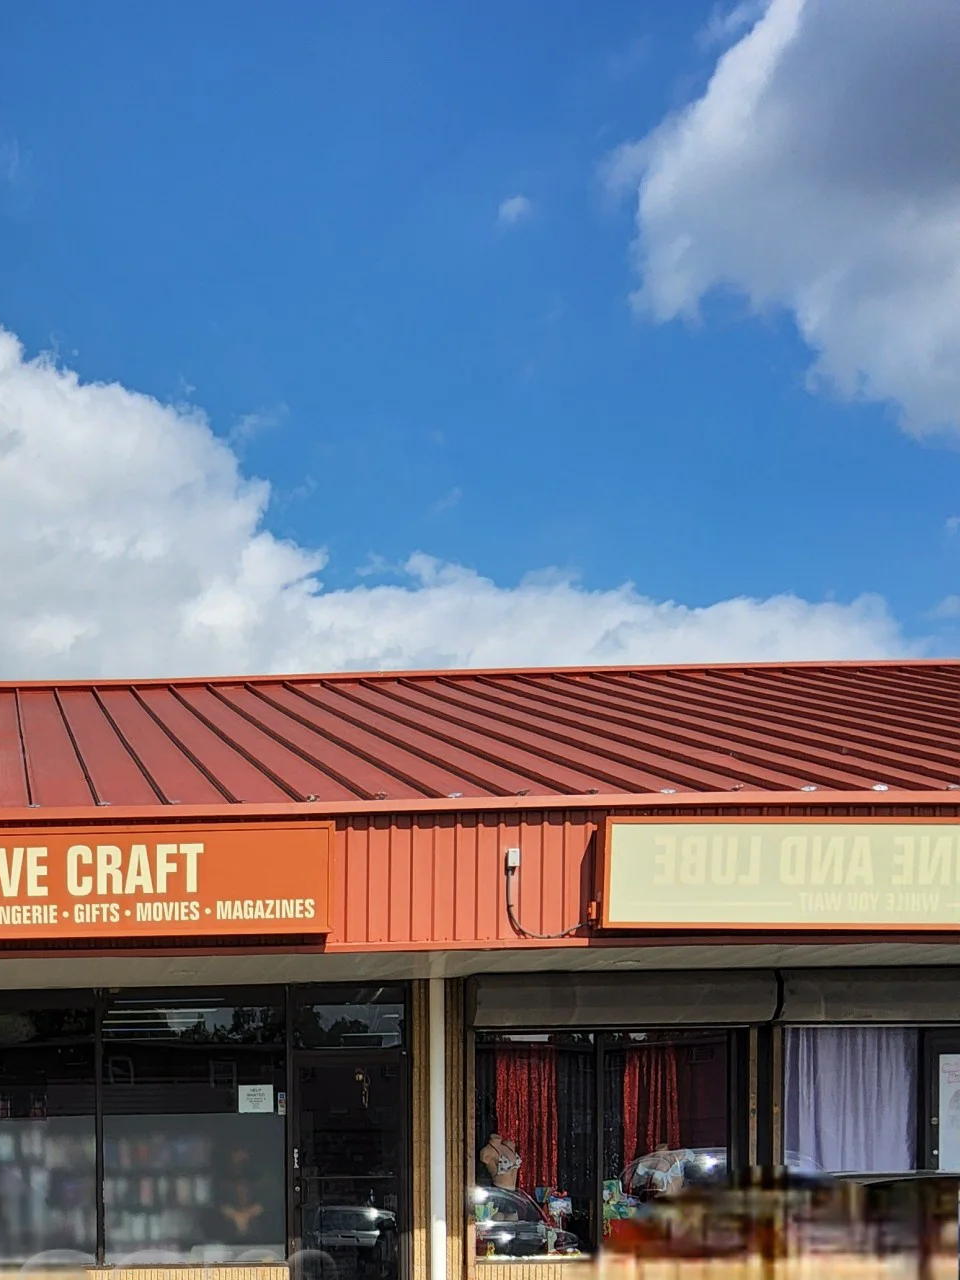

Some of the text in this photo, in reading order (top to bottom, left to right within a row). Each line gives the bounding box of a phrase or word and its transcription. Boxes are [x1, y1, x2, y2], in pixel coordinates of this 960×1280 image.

[66, 843, 204, 896] CRAFT
[74, 903, 120, 923] GIFTS
[136, 901, 200, 922] MOVIES
[216, 899, 315, 920] MAGAZINES
